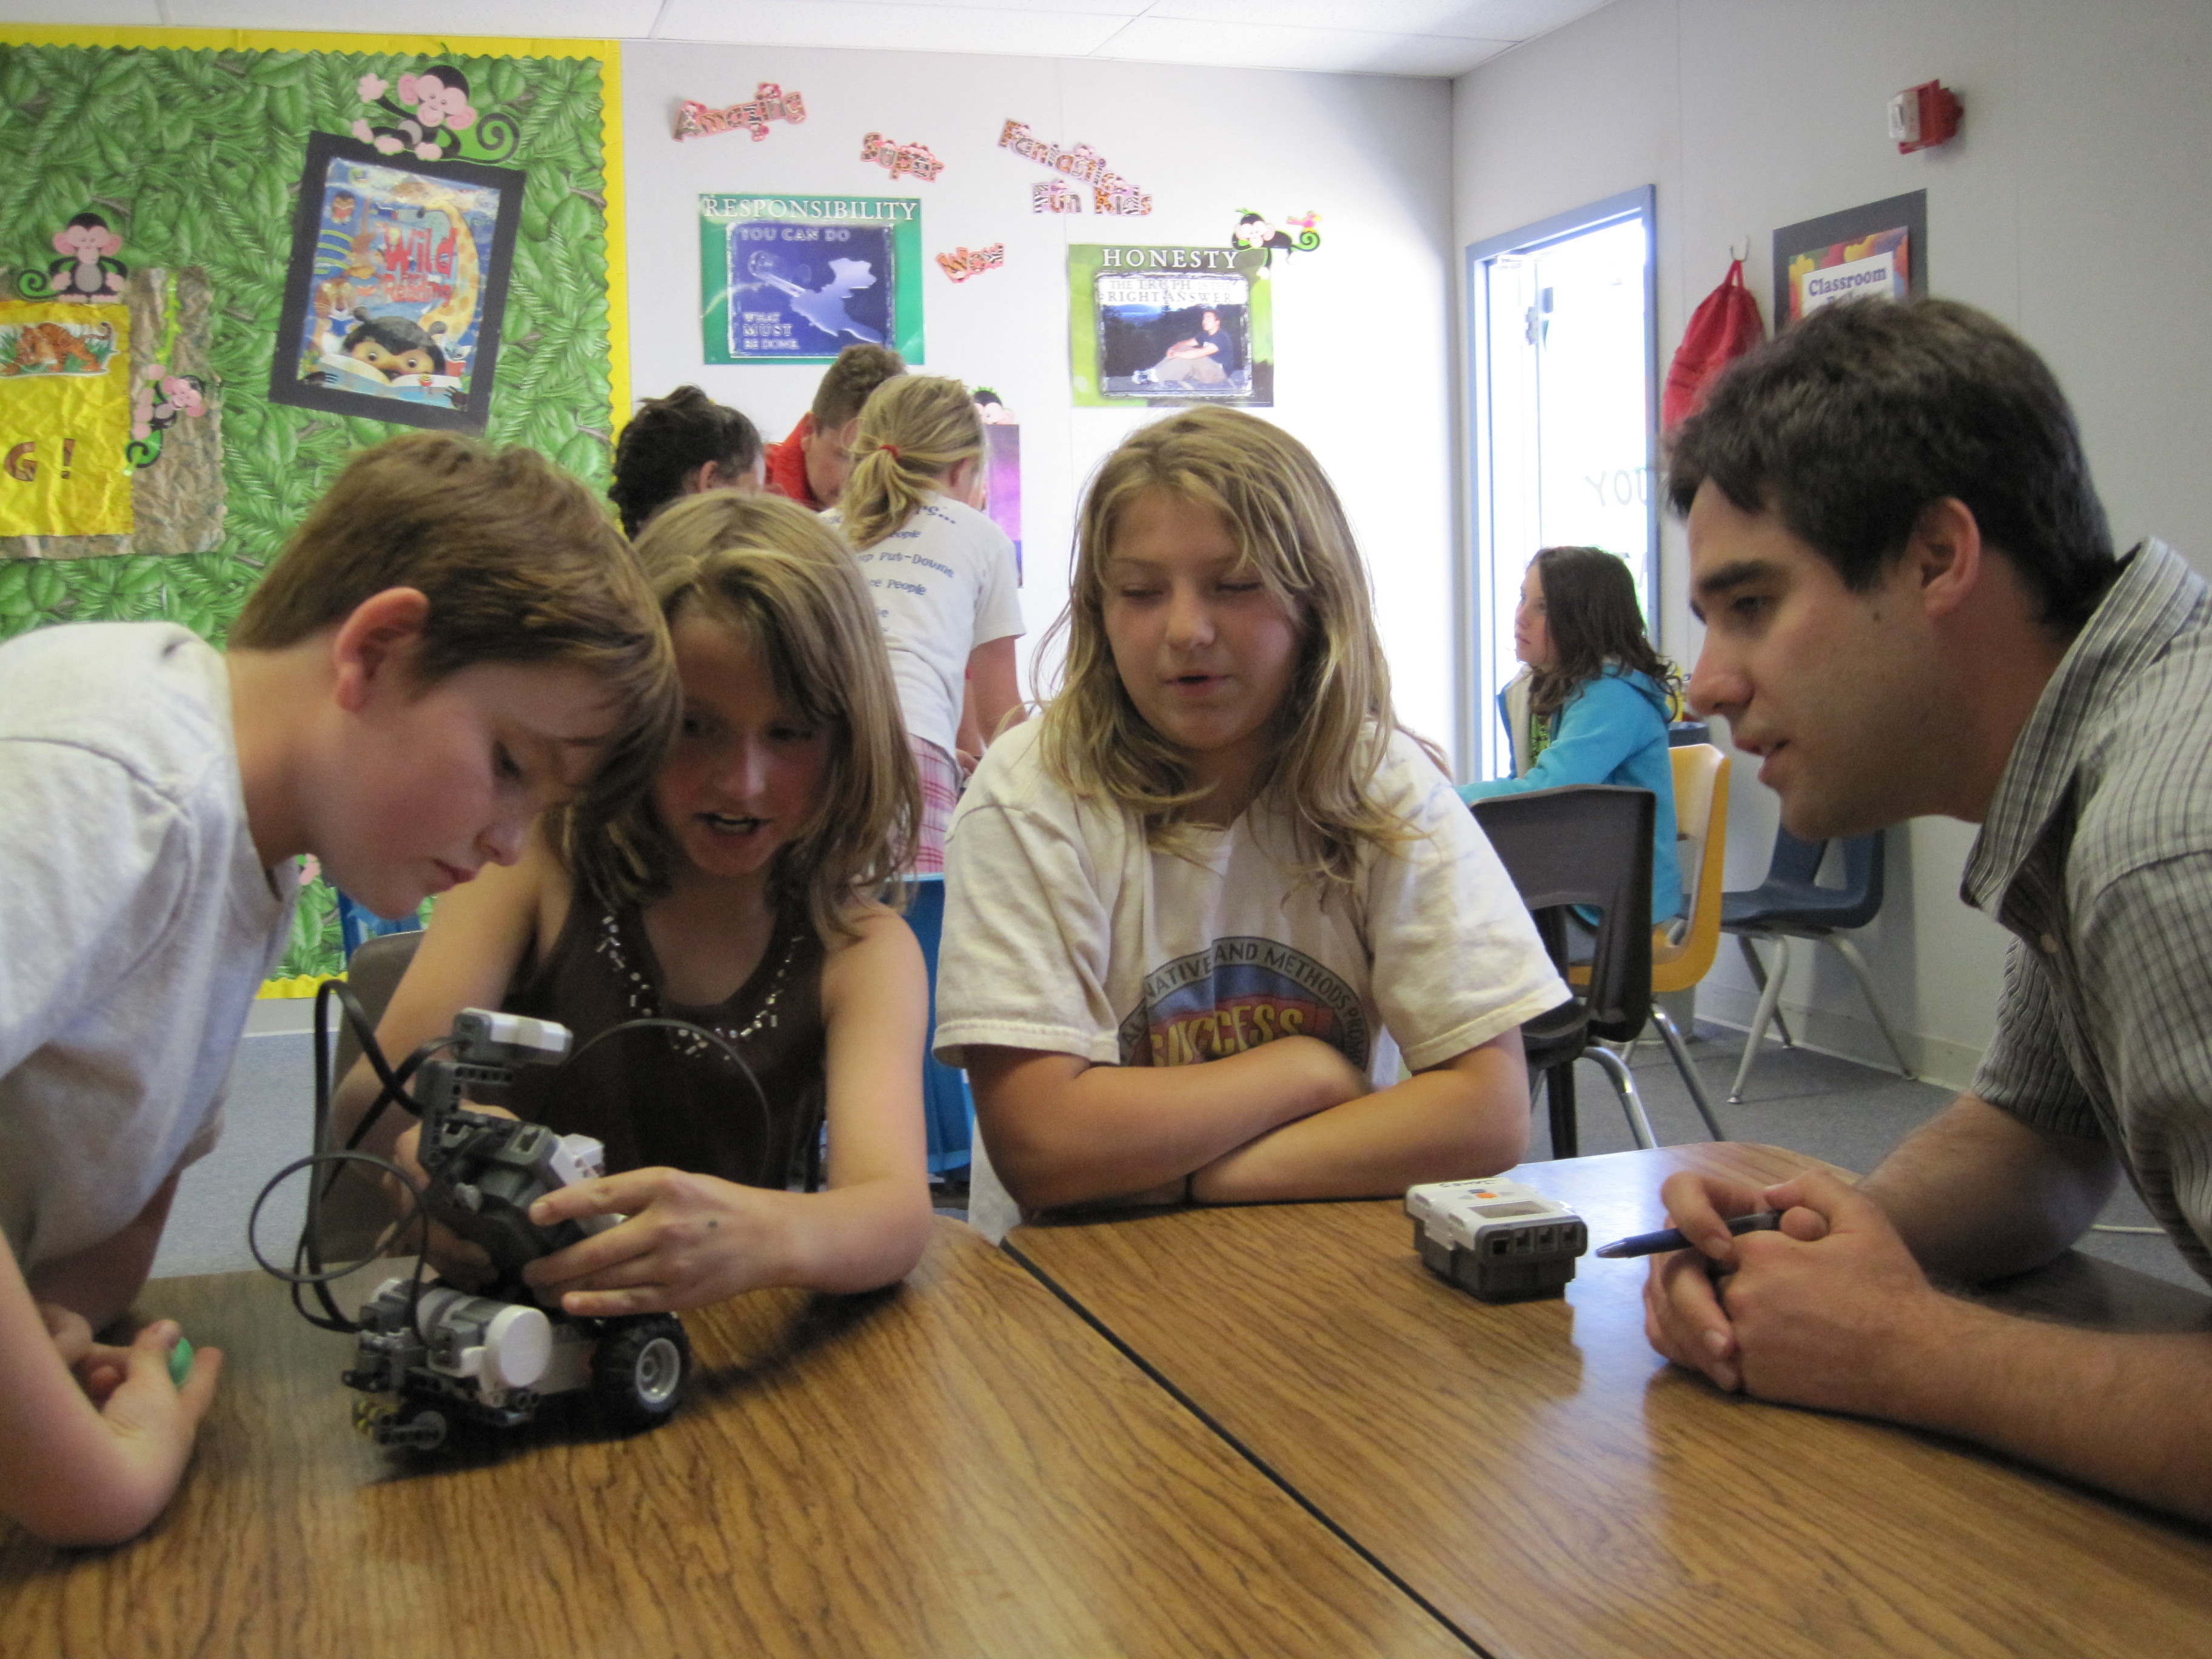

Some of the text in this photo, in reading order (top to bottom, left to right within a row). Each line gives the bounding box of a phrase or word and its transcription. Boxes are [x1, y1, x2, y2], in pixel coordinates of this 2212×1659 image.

[674, 92, 803, 141] Amazing
[861, 133, 943, 181] Super
[999, 120, 1116, 193] Fantastic
[704, 199, 917, 220] RESPONSIBILITY
[1034, 184, 1151, 216] Fun Kids
[740, 229, 850, 242] YOU CAN DO
[384, 226, 458, 279] Wild
[1102, 249, 1239, 269] HONESTY
[1111, 280, 1133, 289] THE
[1138, 280, 1191, 290] TRUTH
[1808, 268, 1886, 296] Classroom
[1108, 291, 1232, 303] RIGHT ANSWER
[743, 323, 791, 336] MUST
[886, 578, 927, 595] People
[1215, 942, 1258, 963] AND
[1264, 950, 1352, 1011] METHODS
